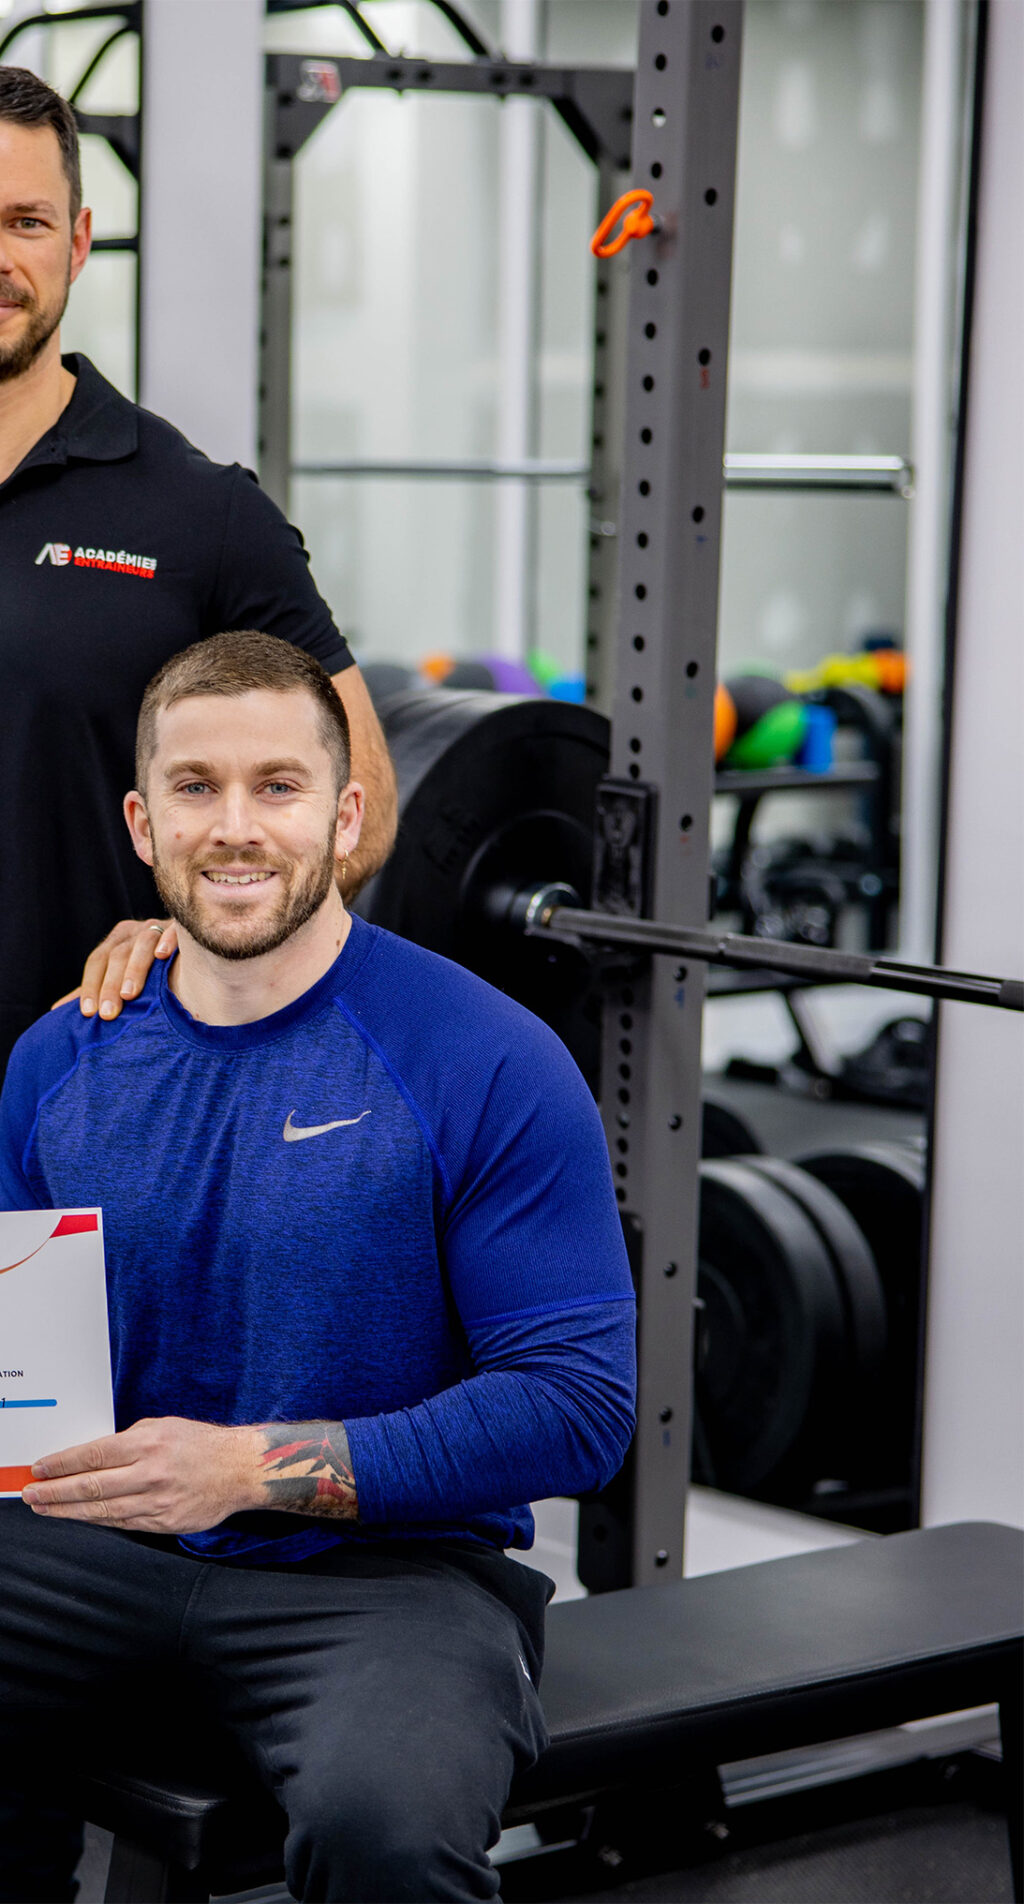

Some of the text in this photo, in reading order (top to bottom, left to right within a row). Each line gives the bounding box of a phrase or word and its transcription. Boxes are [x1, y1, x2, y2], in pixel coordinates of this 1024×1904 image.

[74, 547, 152, 570] ACADÉMIE
[74, 557, 155, 579] ENTRAINEURS
[0, 1397, 7, 1409] 1
